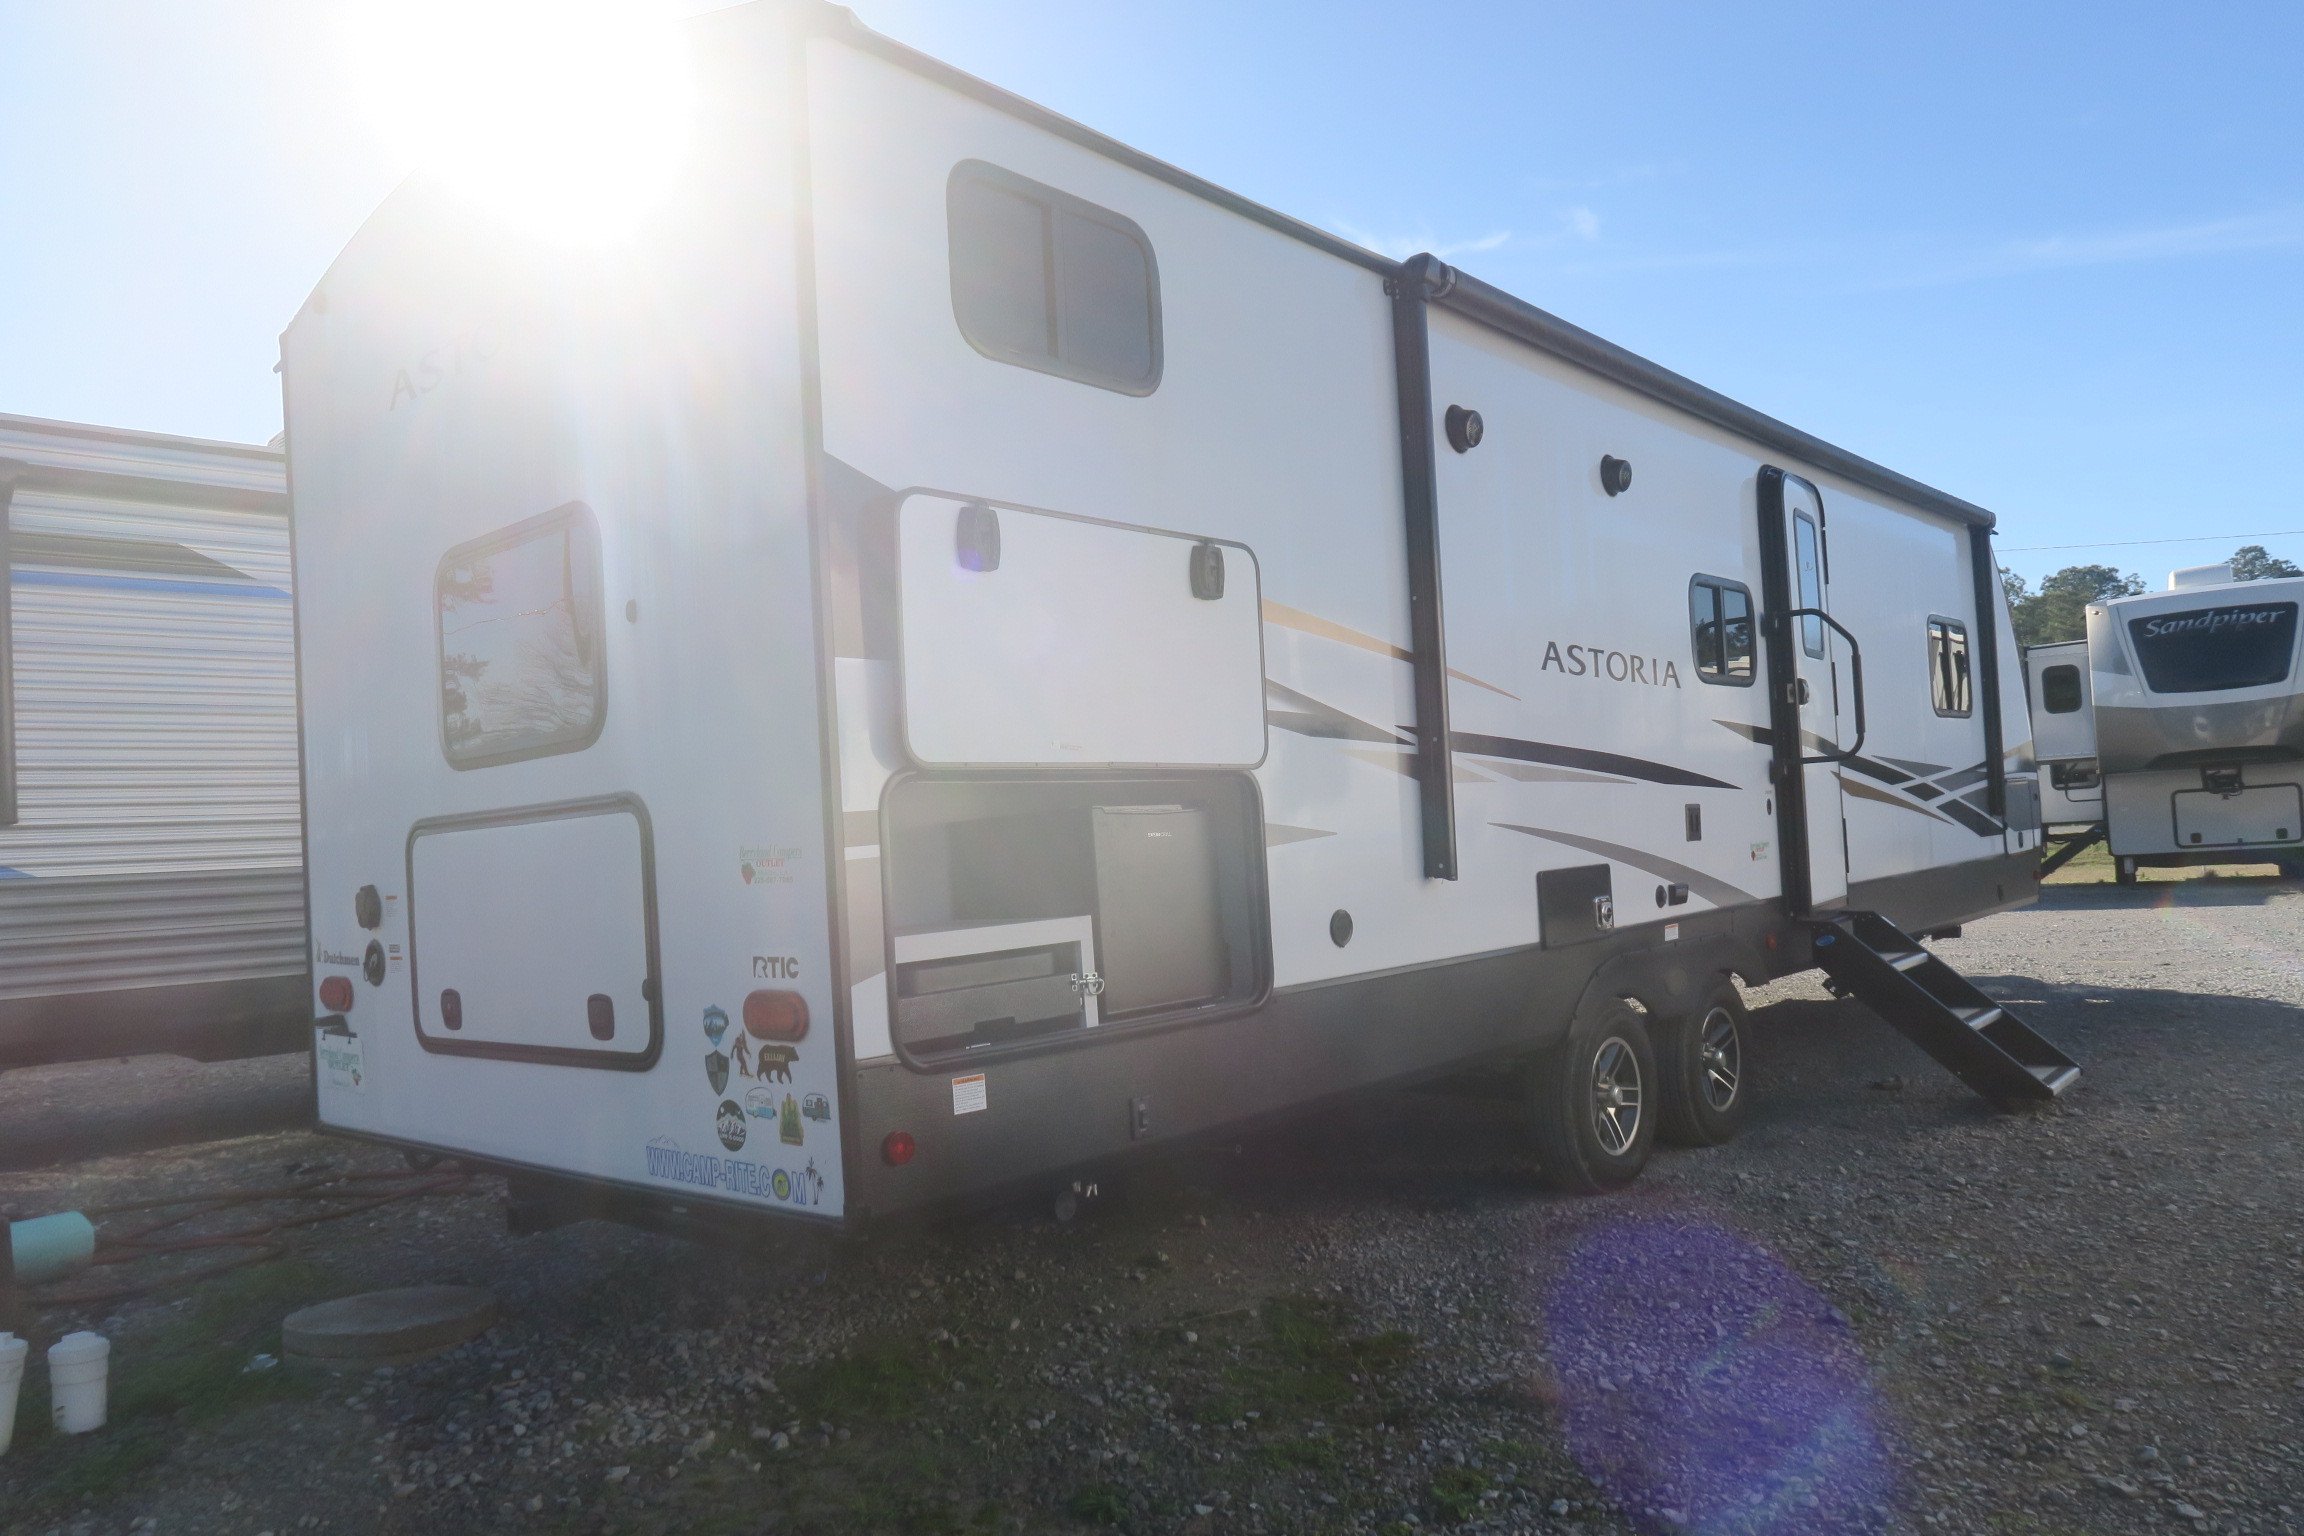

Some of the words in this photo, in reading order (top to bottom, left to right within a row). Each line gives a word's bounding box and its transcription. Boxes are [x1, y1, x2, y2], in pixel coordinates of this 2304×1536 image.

[2143, 609, 2286, 638] Sandpiper
[1541, 640, 1682, 689] ASTORIA
[323, 950, 360, 967] Dutchmen
[752, 956, 800, 979] RTIC
[645, 1145, 807, 1206] WWW.CAMP-RITE.COM
